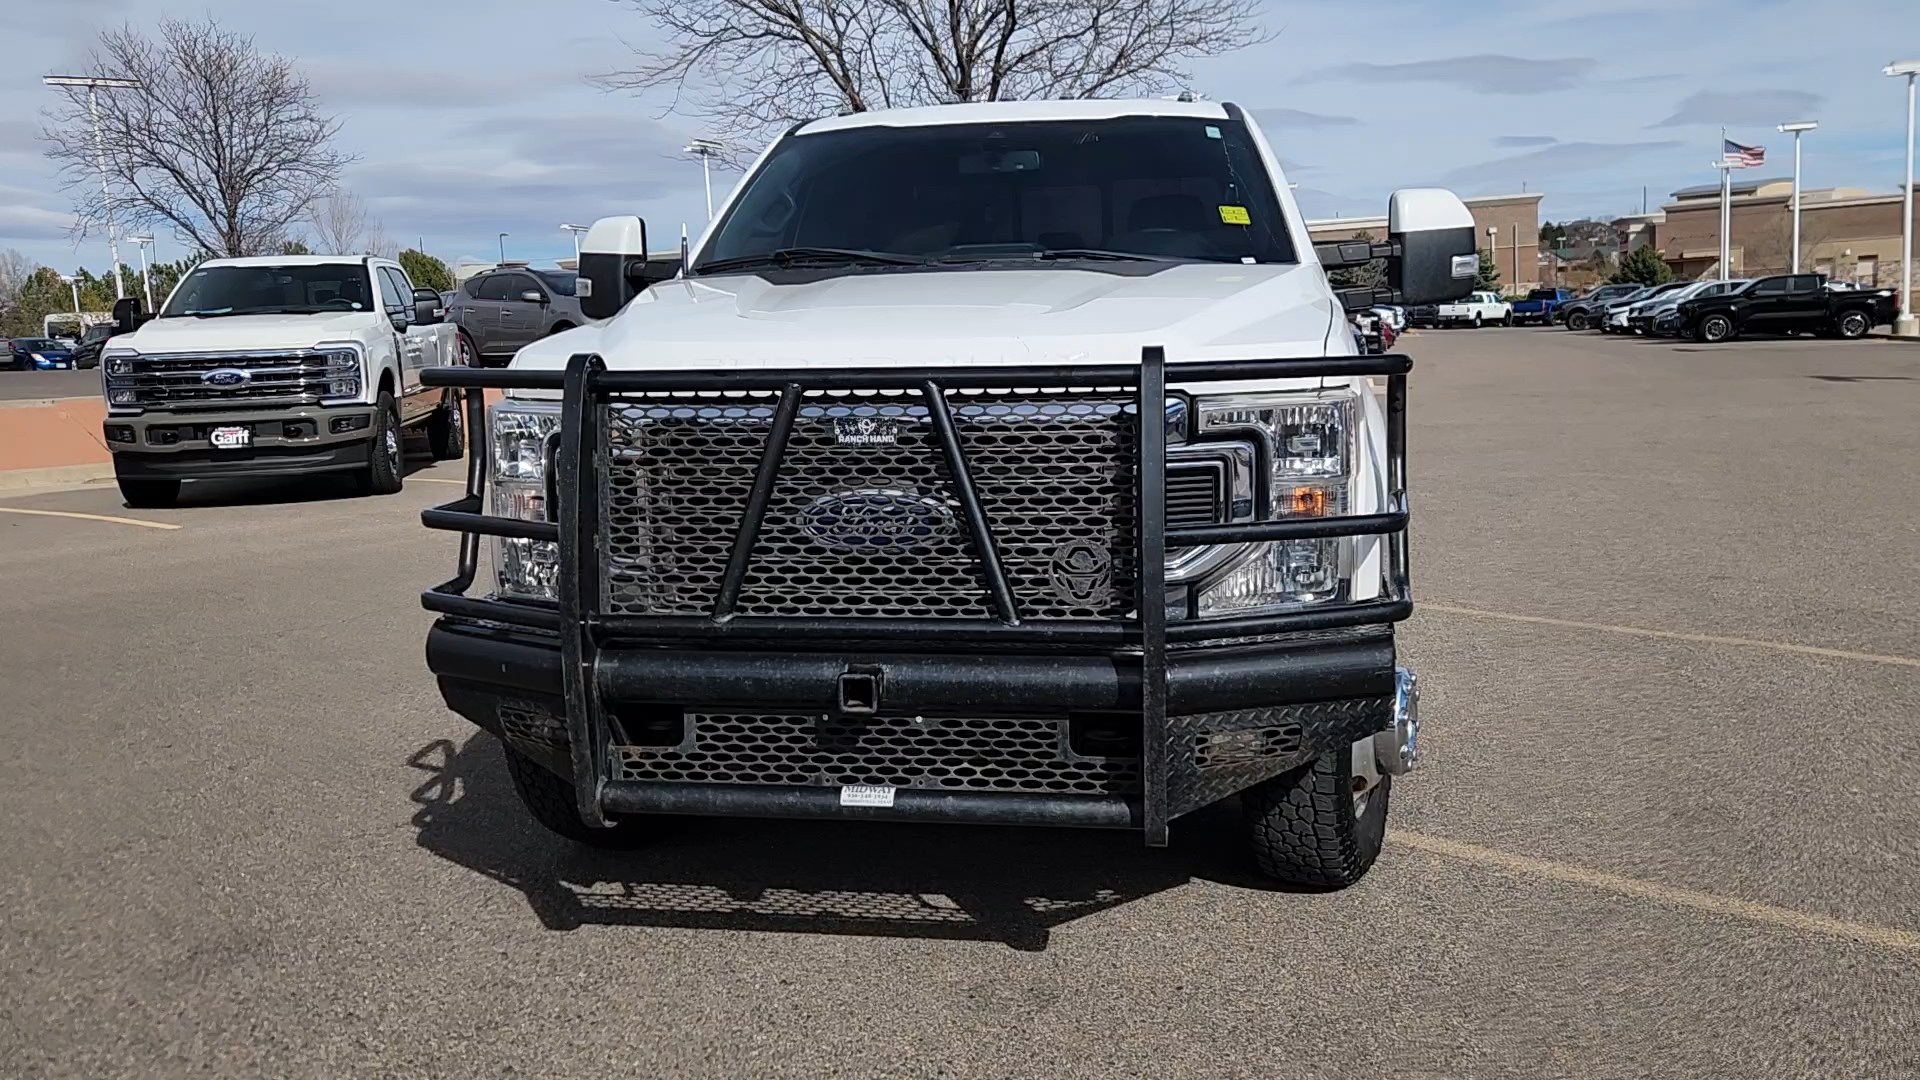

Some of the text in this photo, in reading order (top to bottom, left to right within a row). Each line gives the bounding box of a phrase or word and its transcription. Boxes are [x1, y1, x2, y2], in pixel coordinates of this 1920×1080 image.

[210, 429, 250, 446] Garff
[838, 434, 895, 444] RANCH HAND
[843, 785, 893, 794] MIDWAY
